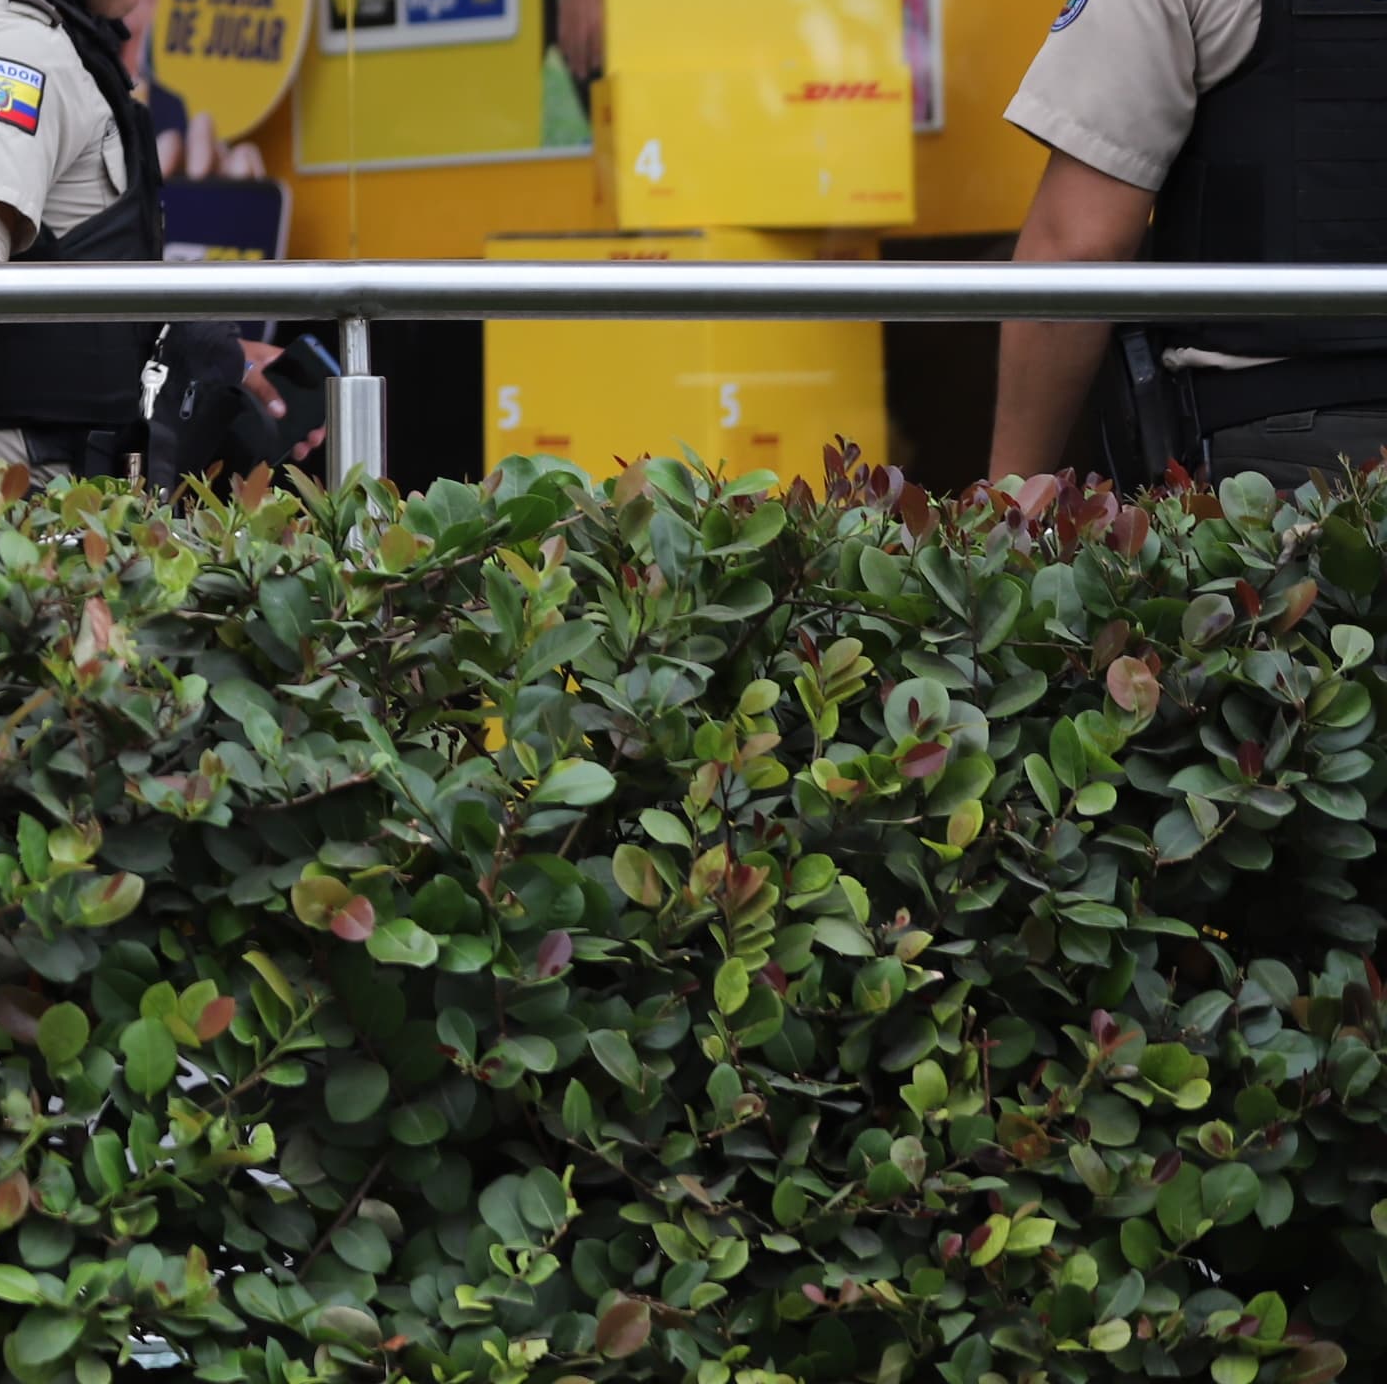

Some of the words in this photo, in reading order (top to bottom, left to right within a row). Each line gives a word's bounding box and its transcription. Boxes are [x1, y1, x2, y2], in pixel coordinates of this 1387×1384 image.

[166, 7, 198, 56] DE
[204, 15, 287, 63] JUGAR
[802, 80, 881, 101] DHL
[634, 137, 667, 184] 4
[497, 384, 522, 432] 5
[718, 381, 742, 430] 5
